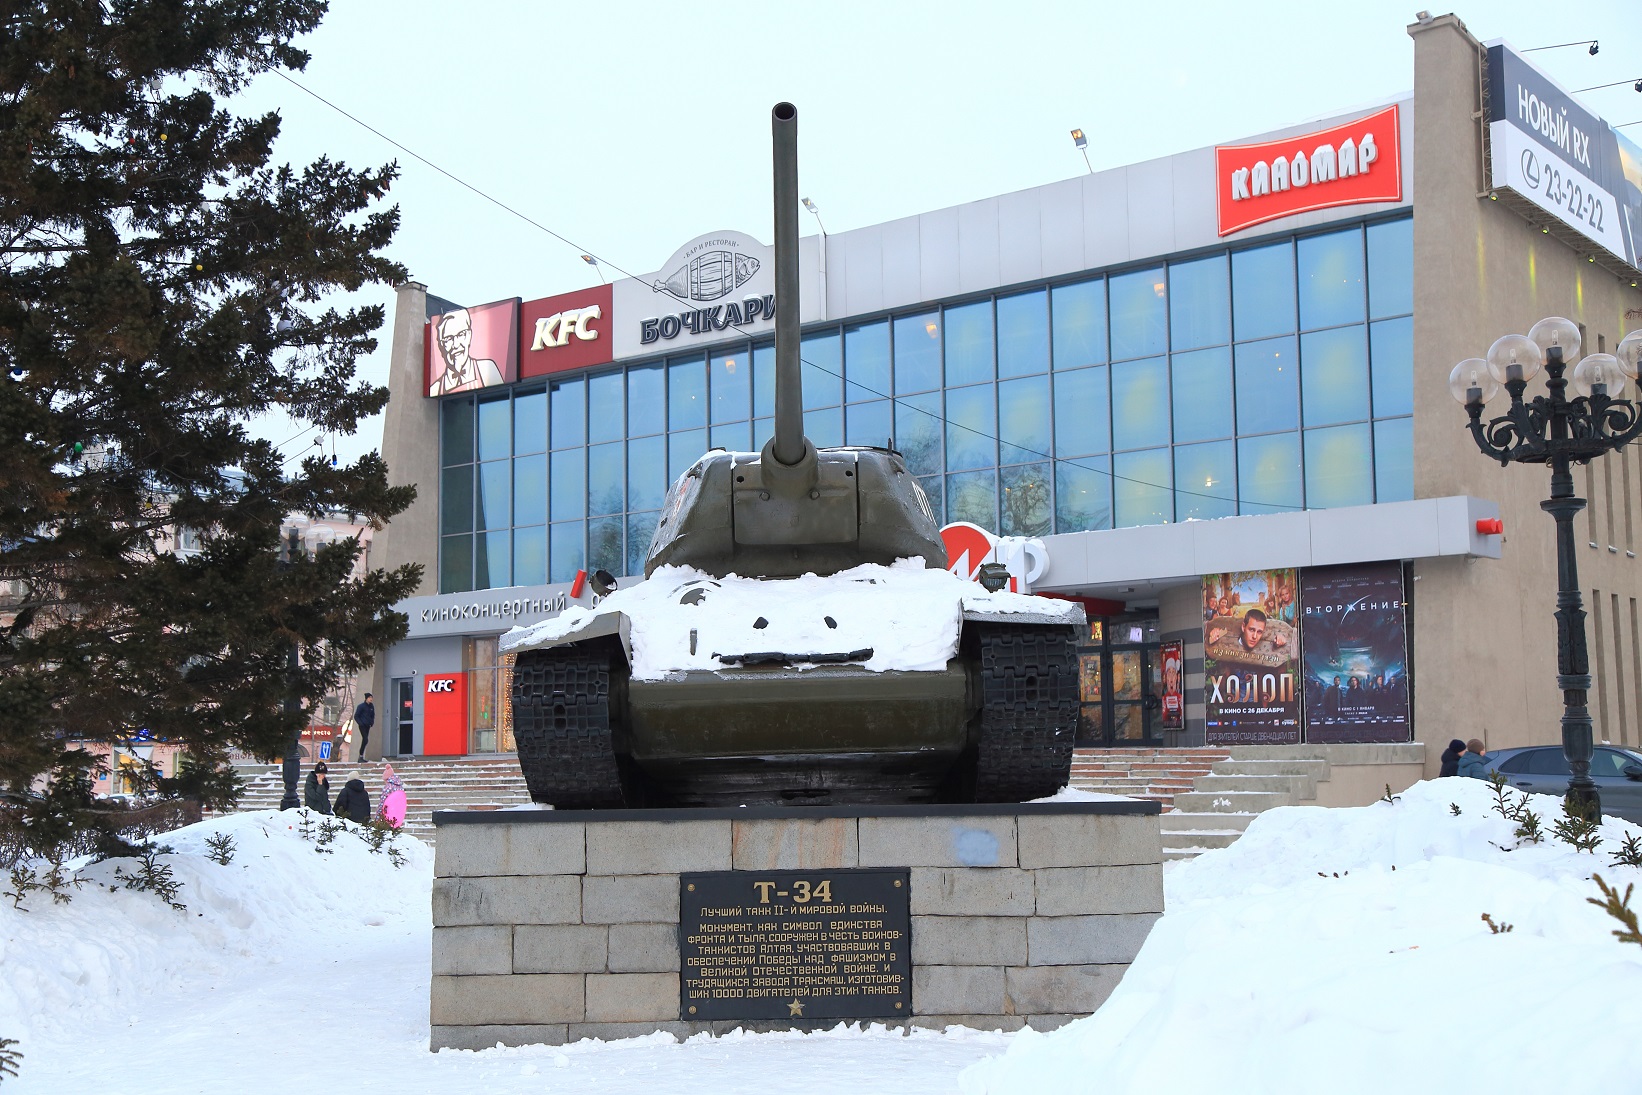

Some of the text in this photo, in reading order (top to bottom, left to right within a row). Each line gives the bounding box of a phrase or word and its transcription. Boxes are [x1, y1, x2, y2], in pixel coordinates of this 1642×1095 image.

[1518, 83, 1591, 169] НОВЫЙ RX
[1231, 136, 1379, 201] КИНОМИР
[1544, 163, 1604, 234] 23-22-22
[685, 246, 698, 258] БАР
[704, 239, 737, 248] РЕСТОРАН
[530, 305, 602, 351] KFC
[1305, 600, 1400, 615] ВТОРЖЕНИЕ
[427, 679, 456, 693] KFC
[1210, 673, 1294, 704] ХОЛОП
[753, 880, 832, 904] Т-34
[712, 988, 744, 998] 10000
